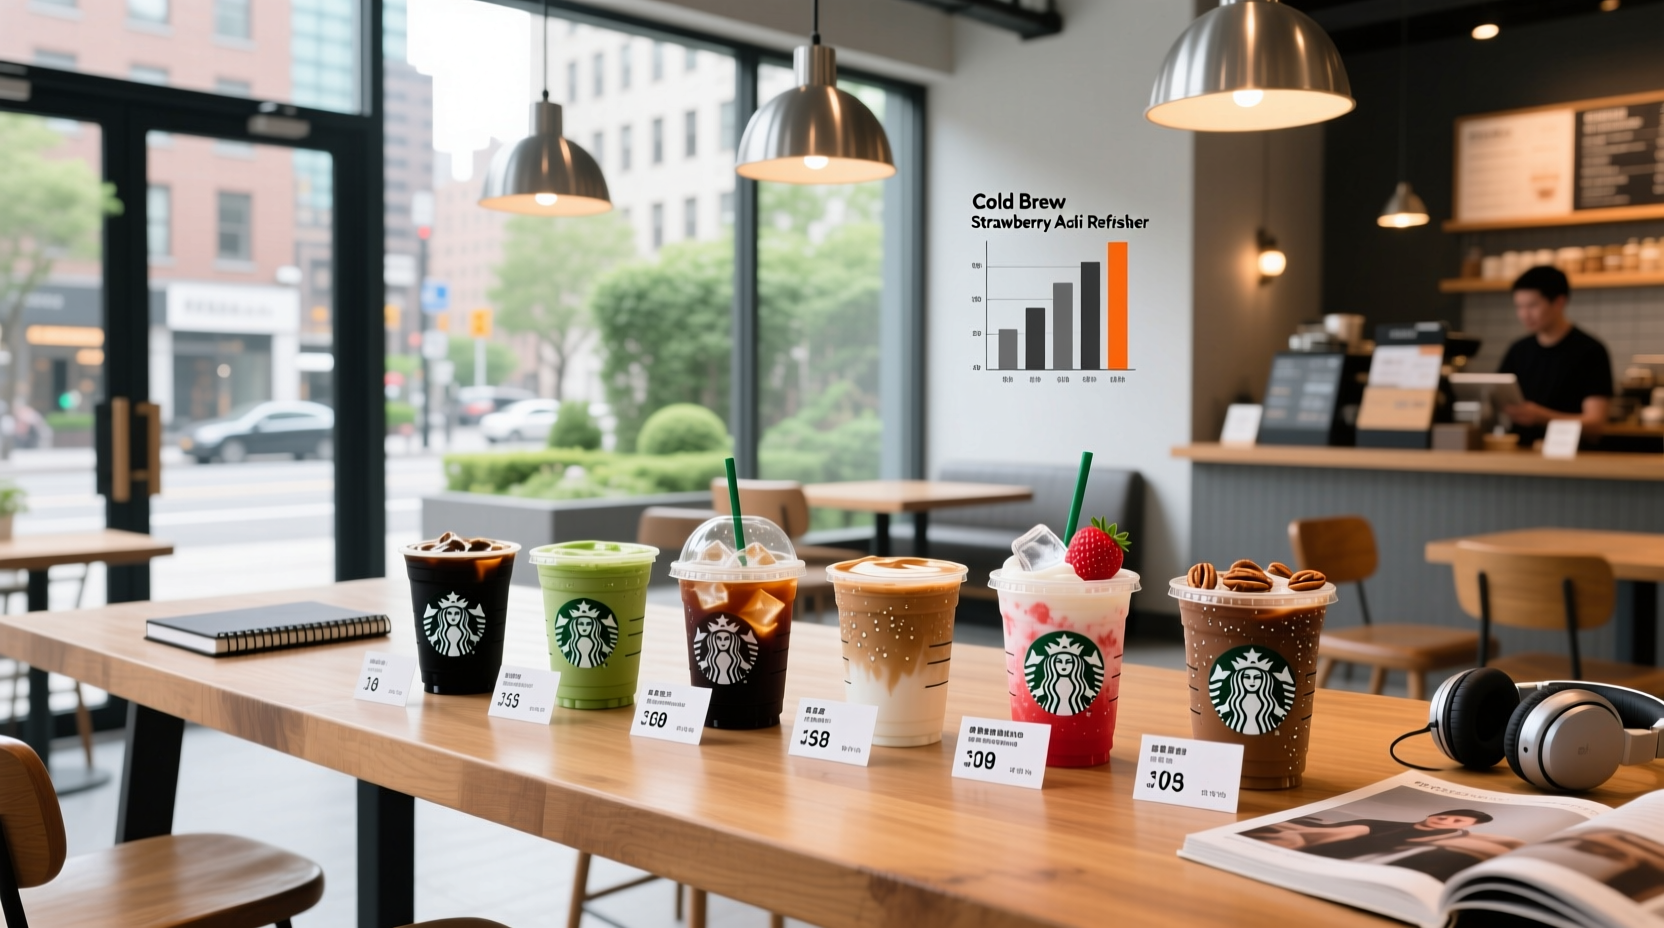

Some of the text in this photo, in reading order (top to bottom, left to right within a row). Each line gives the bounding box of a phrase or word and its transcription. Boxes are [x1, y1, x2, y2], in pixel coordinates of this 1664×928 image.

[972, 192, 1066, 209] Cold Brew
[971, 214, 1051, 232] Strawberry
